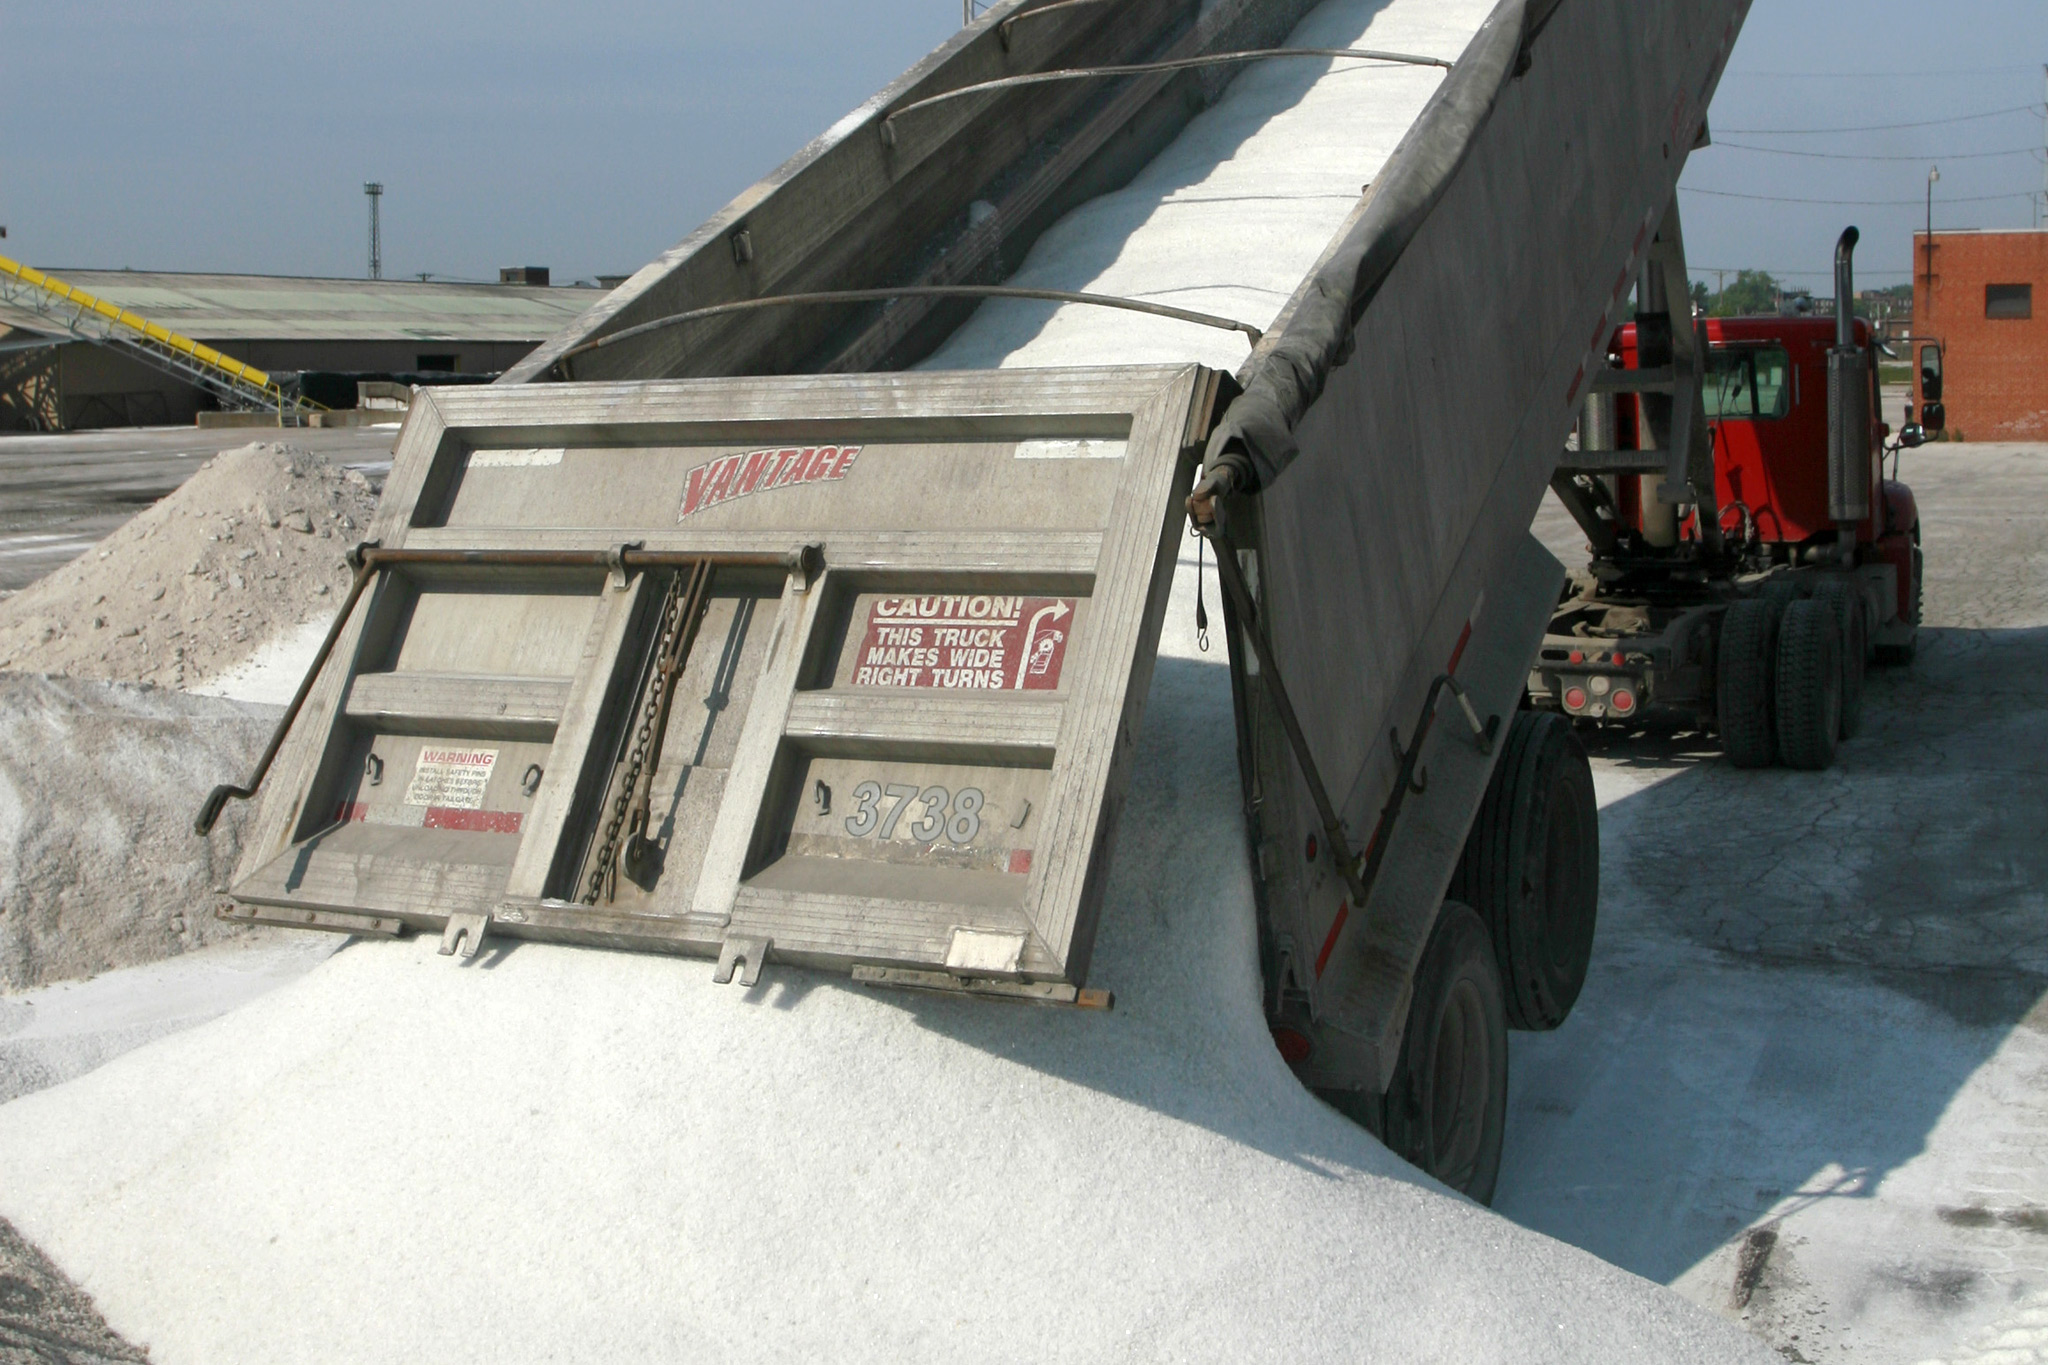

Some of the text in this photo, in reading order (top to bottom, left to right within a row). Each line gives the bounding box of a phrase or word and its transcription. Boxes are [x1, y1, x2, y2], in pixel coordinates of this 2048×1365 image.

[677, 445, 864, 523] VANTAGE
[876, 595, 1024, 619] CAUTION!
[876, 627, 1007, 648] THIS TRUCK
[866, 647, 1005, 668] MAKES WIDE
[855, 666, 1004, 689] RIGHT TURNS
[423, 750, 494, 765] WARNING
[446, 768, 470, 777] SAFETY
[471, 769, 487, 778] PINS
[845, 780, 985, 844] 3738
